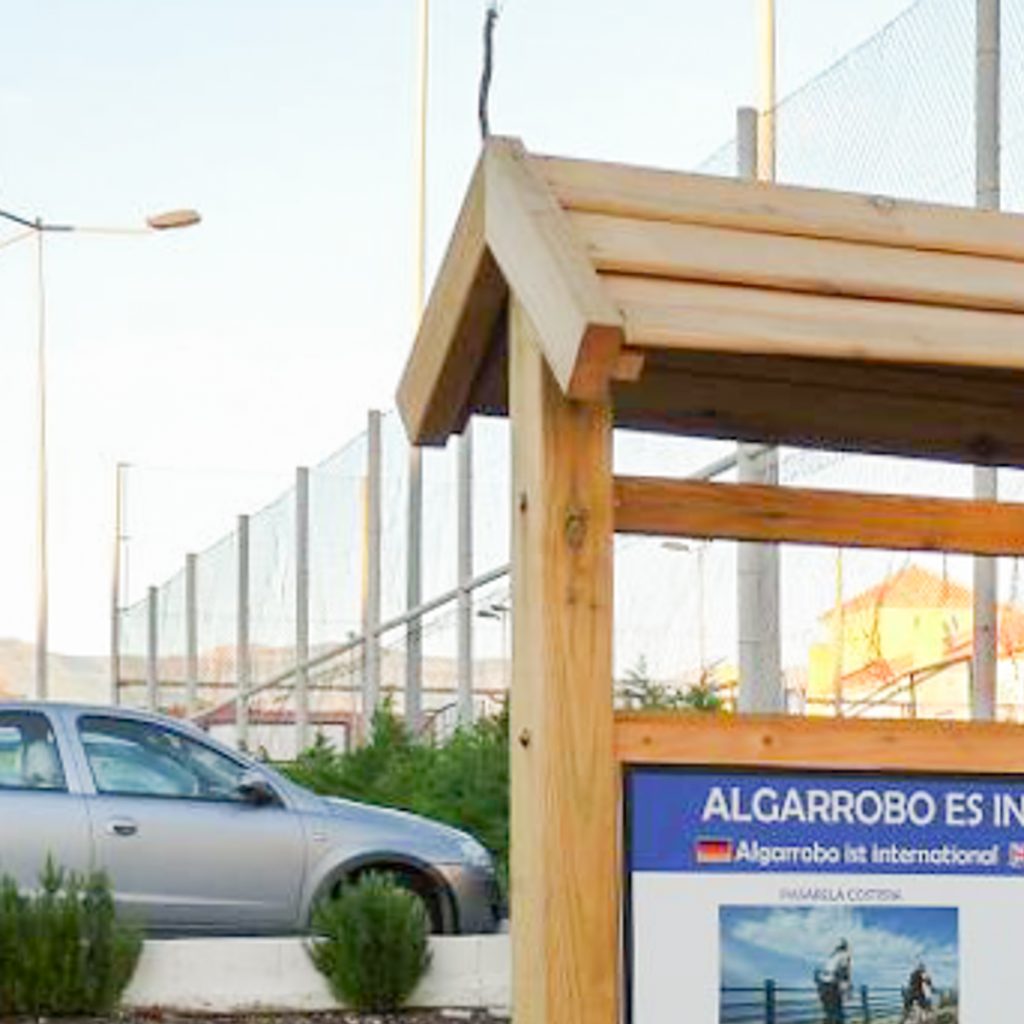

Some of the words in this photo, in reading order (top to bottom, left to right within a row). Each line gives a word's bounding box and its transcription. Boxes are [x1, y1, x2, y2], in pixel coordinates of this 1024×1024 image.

[702, 787, 936, 826] ALGARROBO
[945, 792, 982, 827] ES
[736, 840, 840, 866] Algarrobo
